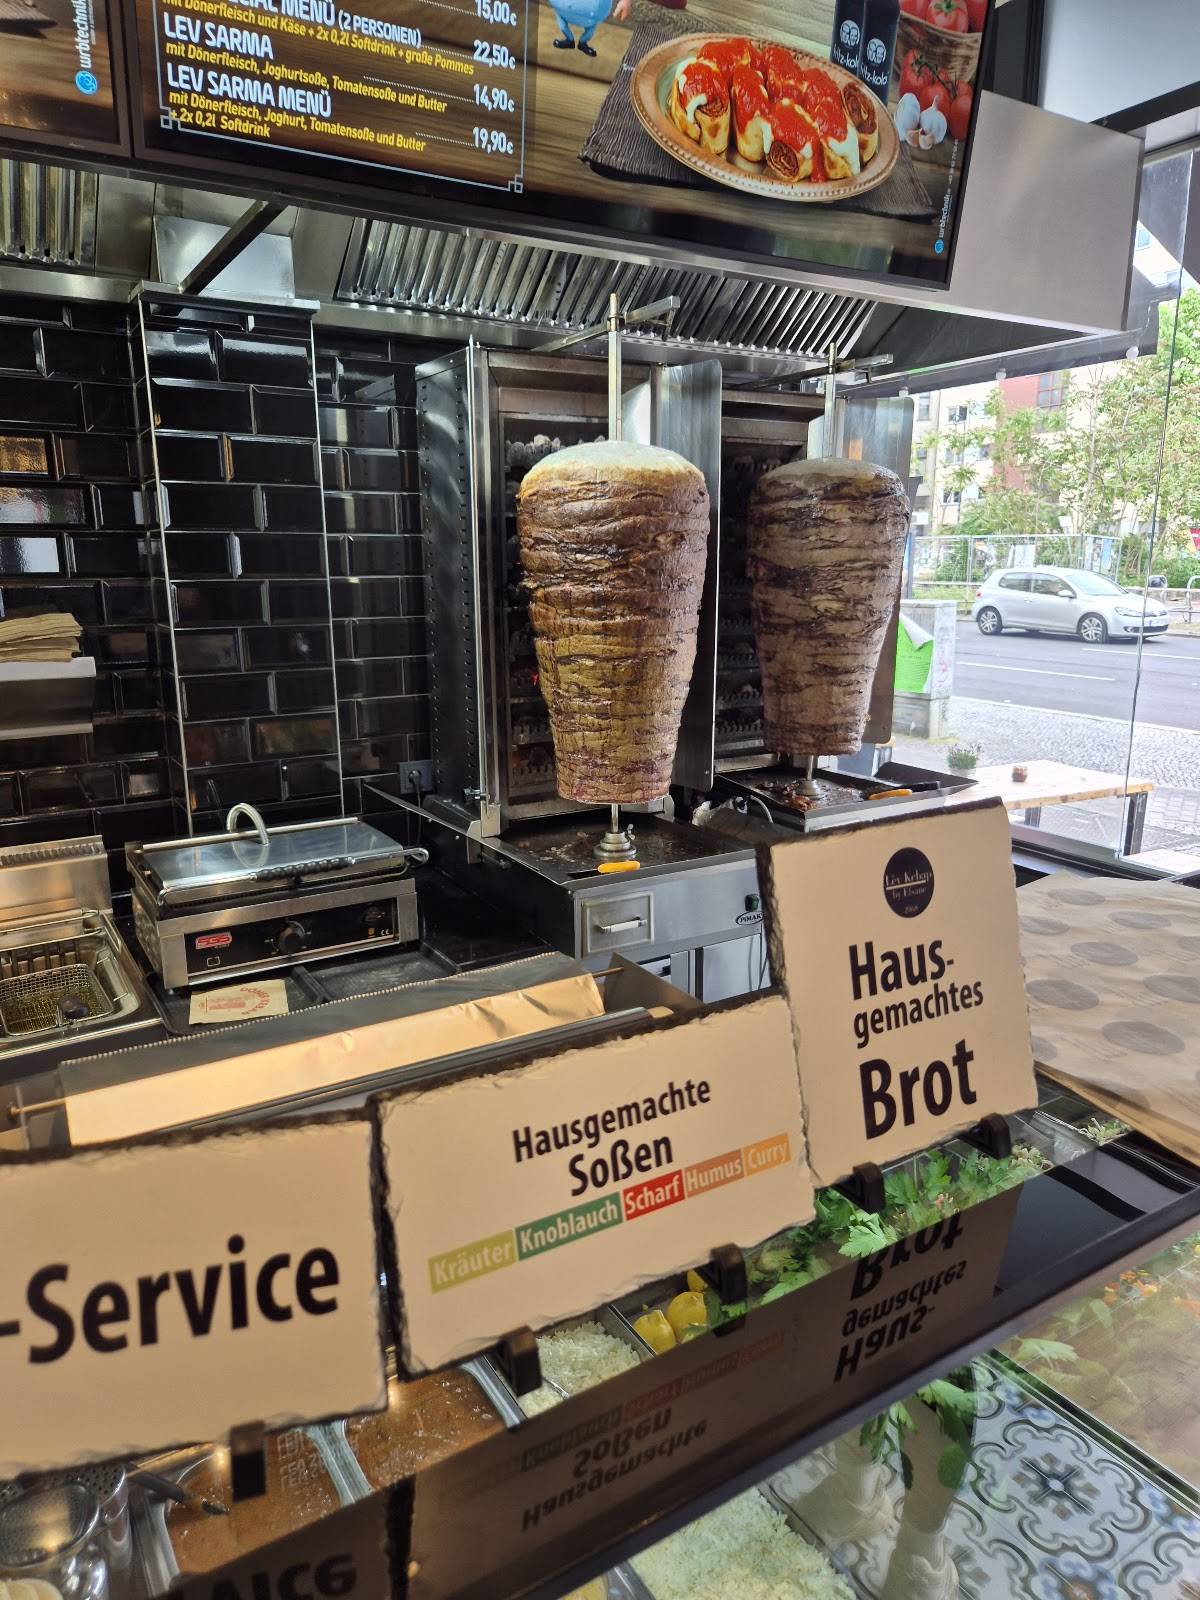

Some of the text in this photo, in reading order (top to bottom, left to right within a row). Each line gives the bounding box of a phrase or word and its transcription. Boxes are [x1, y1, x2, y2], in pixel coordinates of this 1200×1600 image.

[163, 11, 274, 60] LEV SARMA
[258, 15, 279, 29] und
[280, 16, 307, 36] Käse
[316, 26, 329, 41] 2x
[351, 35, 396, 57] Softdrink
[405, 49, 433, 64] große
[434, 53, 475, 75] Pommes
[353, 15, 422, 49] PERSONEN)
[474, 39, 516, 69] 22,50€
[166, 42, 448, 112] mit Dönerfleisch, Joghurtsoße, Tomatensoße und Butter
[166, 62, 332, 118] LEV SARMA MENÜ
[473, 83, 515, 112] 14,90€
[169, 91, 427, 152] mit Dönerfleisch, Joghurt, Tomatensoße und Butter
[180, 108, 193, 123] 2x
[220, 115, 270, 138] Softdrink
[472, 126, 514, 155] 19,90€
[849, 939, 954, 1000] Haus-
[853, 981, 984, 1049] gemachtes
[859, 1039, 977, 1140] Brot
[512, 1079, 711, 1163] Hausgemachte
[568, 1136, 673, 1197] Soßen
[433, 1141, 788, 1285] Kräuter Knoblauch Scharf Humus Curry
[0, 1233, 340, 1365] -Service
